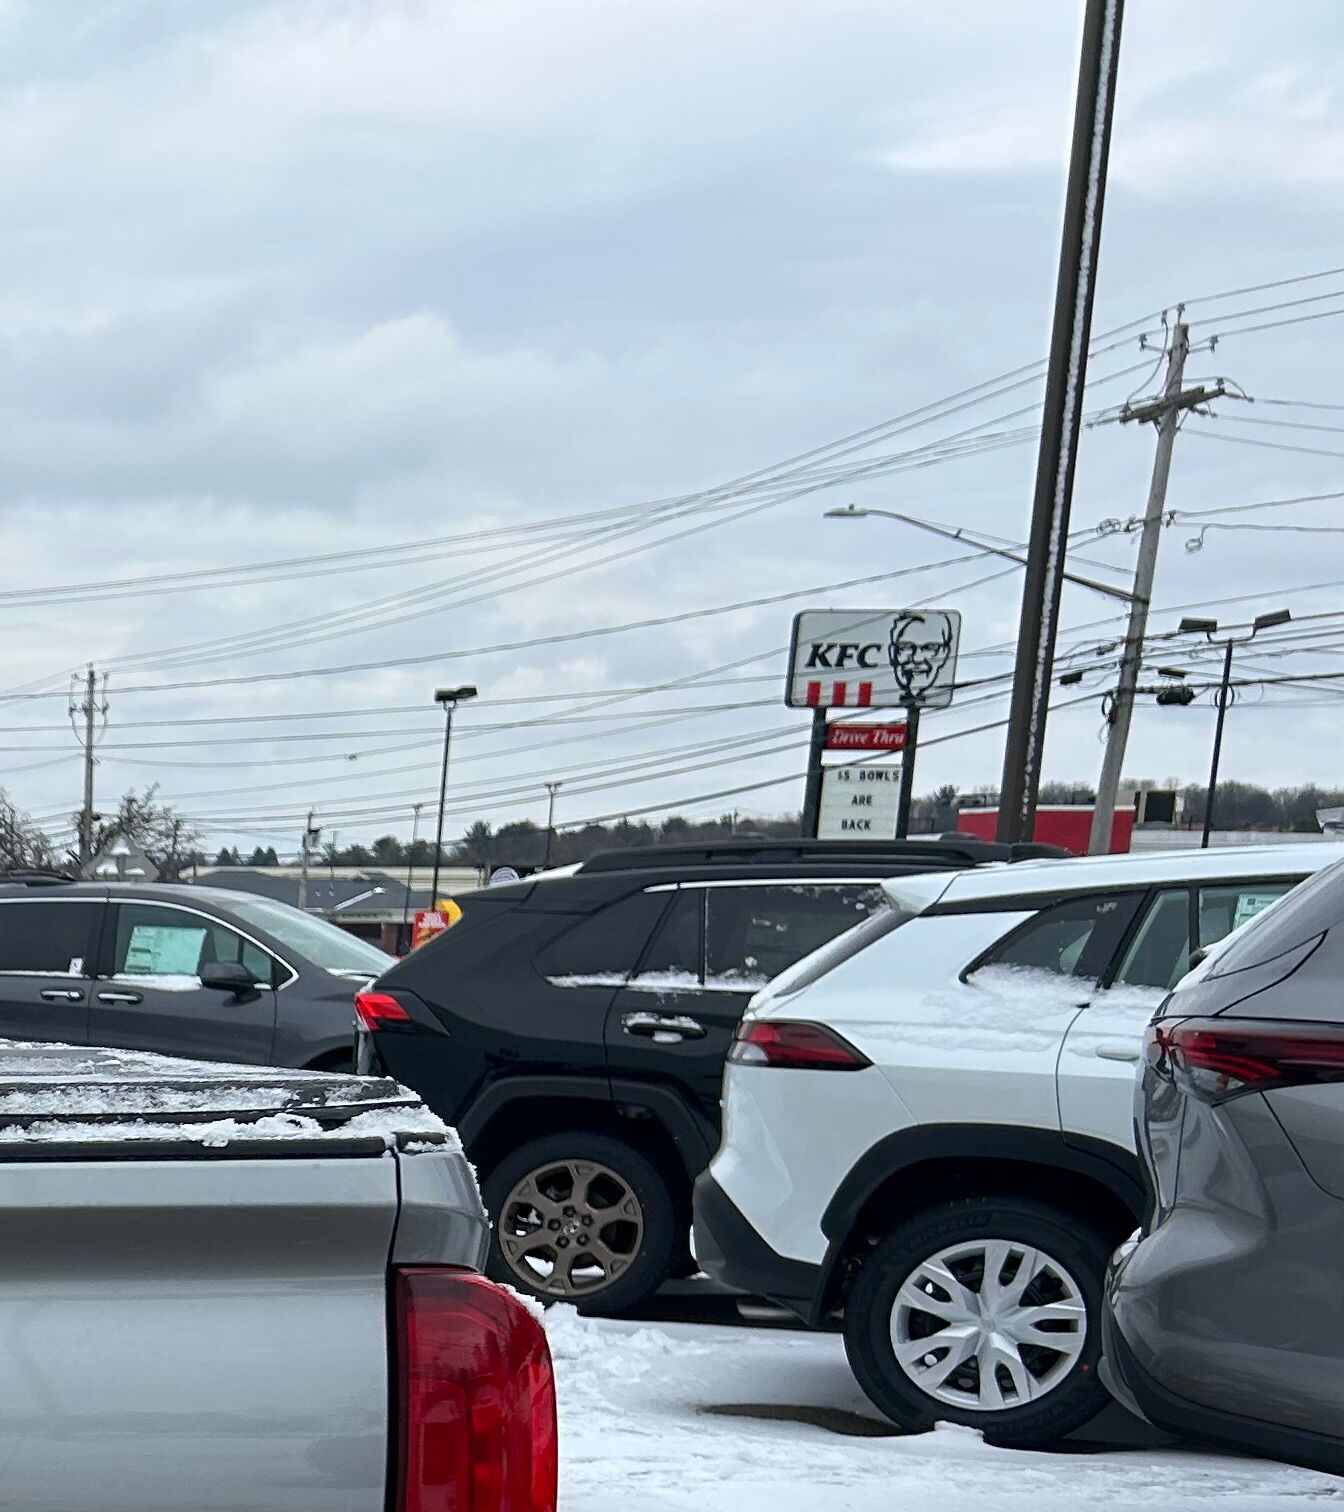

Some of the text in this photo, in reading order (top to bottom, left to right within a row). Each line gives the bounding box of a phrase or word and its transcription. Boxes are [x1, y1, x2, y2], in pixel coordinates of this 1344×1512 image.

[805, 642, 881, 667] KFC
[832, 729, 905, 744] Drive Thru
[859, 769, 900, 782] BOWLS
[851, 794, 873, 806] ARE
[841, 818, 871, 831] BACK
